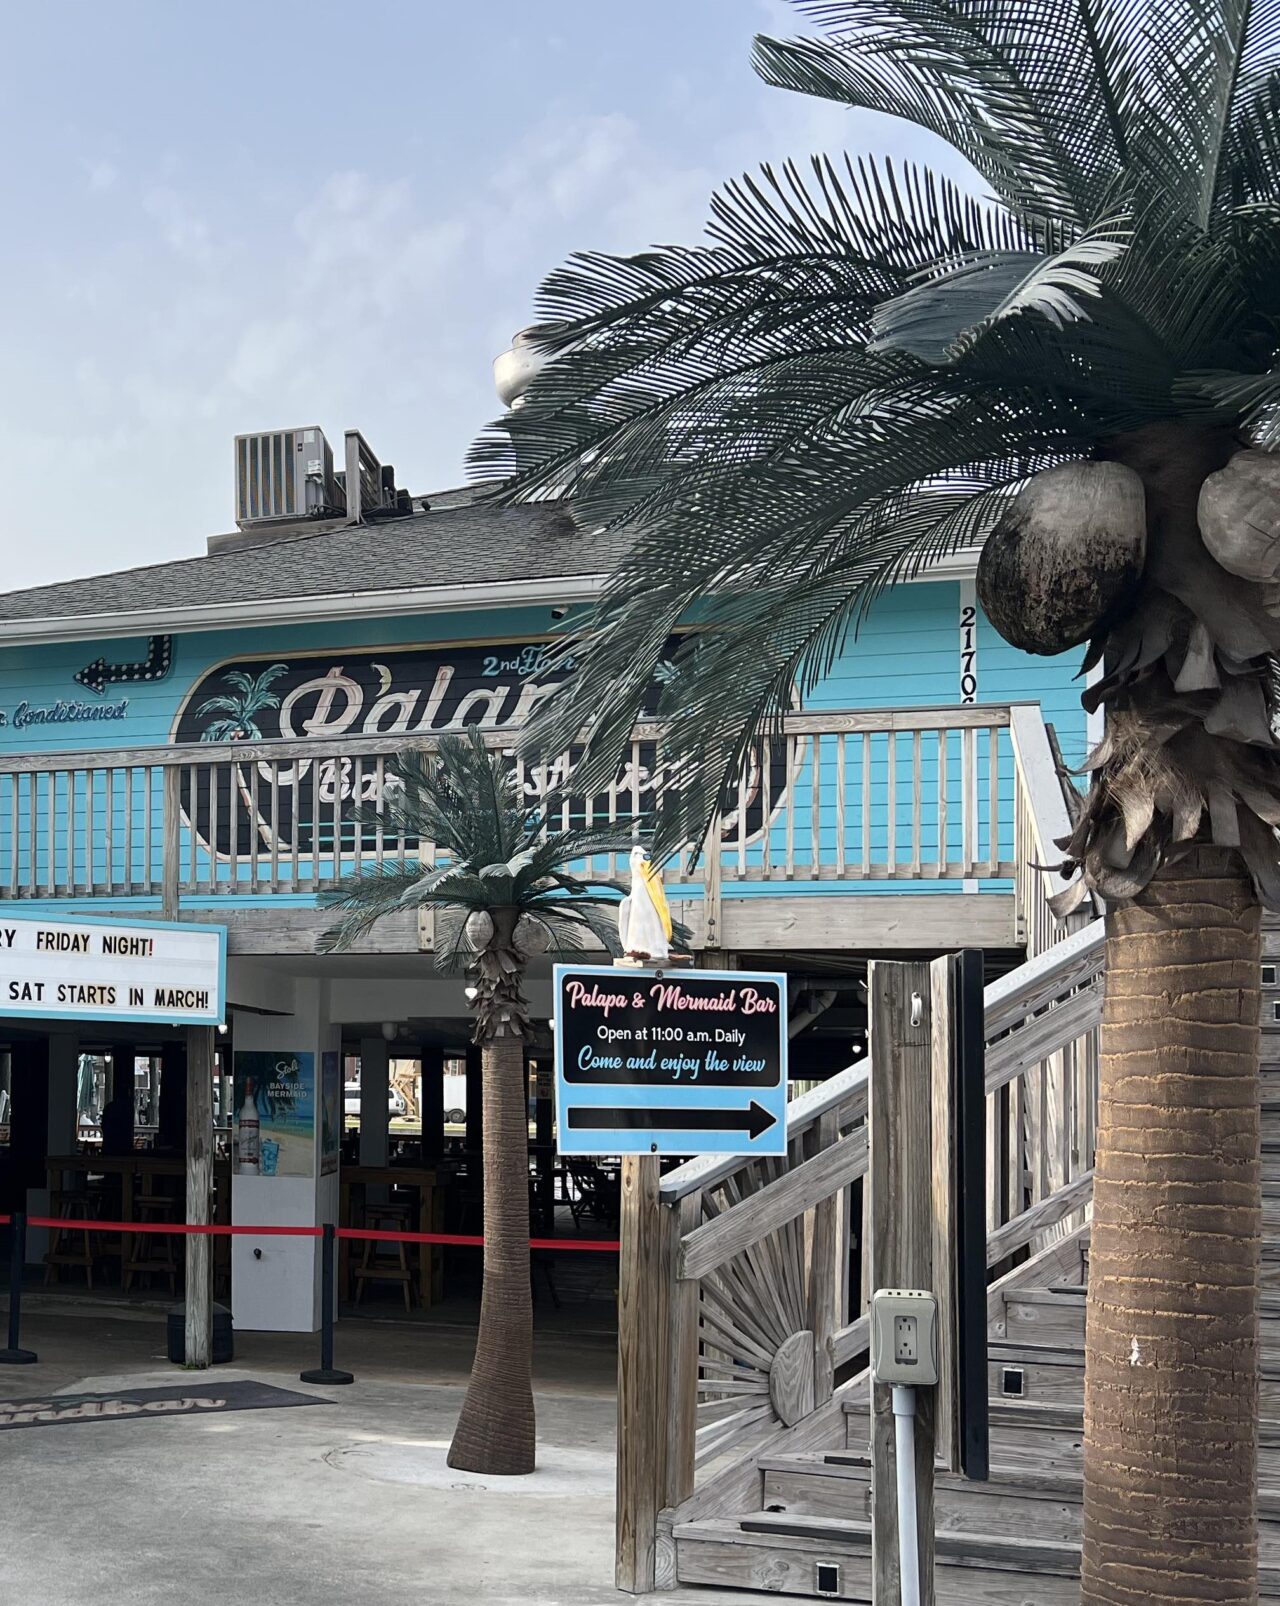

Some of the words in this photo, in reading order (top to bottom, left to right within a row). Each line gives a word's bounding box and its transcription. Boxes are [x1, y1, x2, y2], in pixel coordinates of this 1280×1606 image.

[482, 656, 520, 677] 2nd
[12, 696, 130, 730] Conditioned
[36, 931, 91, 952] FRIDAY
[102, 935, 154, 956] NIGHT!
[8, 981, 45, 1001] SAT
[57, 984, 116, 1005] STARTS
[128, 987, 144, 1006] IN
[154, 989, 209, 1009] MARCH!
[566, 981, 628, 1018] Palapa
[632, 992, 646, 1008] &
[649, 984, 737, 1012] Mermaid
[739, 987, 777, 1015] Bar
[597, 1025, 632, 1043] Open
[635, 1027, 648, 1040] at
[651, 1027, 683, 1041] 11:00
[686, 1031, 712, 1042] a.m.
[715, 1029, 746, 1047] Daily
[577, 1045, 623, 1071] Come
[626, 1049, 657, 1070] and
[660, 1053, 701, 1080] enjoy
[704, 1050, 730, 1072] the
[732, 1054, 766, 1072] view
[267, 1090, 307, 1098] MERMAID
[269, 1082, 305, 1090] BAYSIDE
